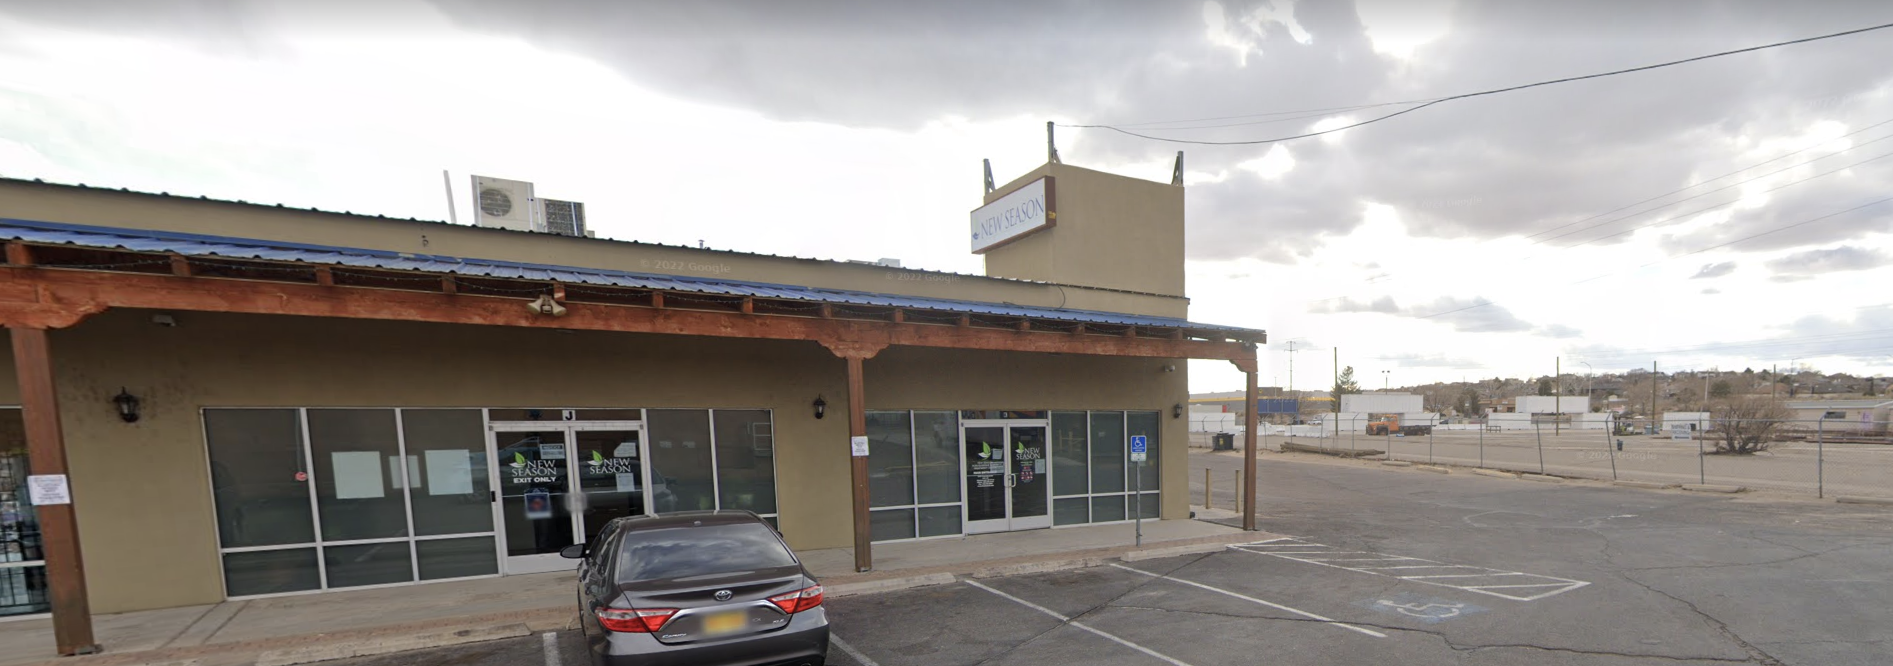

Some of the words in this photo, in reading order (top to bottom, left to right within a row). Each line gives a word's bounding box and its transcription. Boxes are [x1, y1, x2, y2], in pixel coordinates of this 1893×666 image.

[981, 213, 1003, 239] NEW
[1004, 195, 1044, 229] SEASON
[565, 411, 573, 421] J
[527, 460, 556, 468] NEW
[604, 458, 631, 466] NEW
[512, 467, 557, 477] SEASON
[590, 465, 631, 474] SEASON
